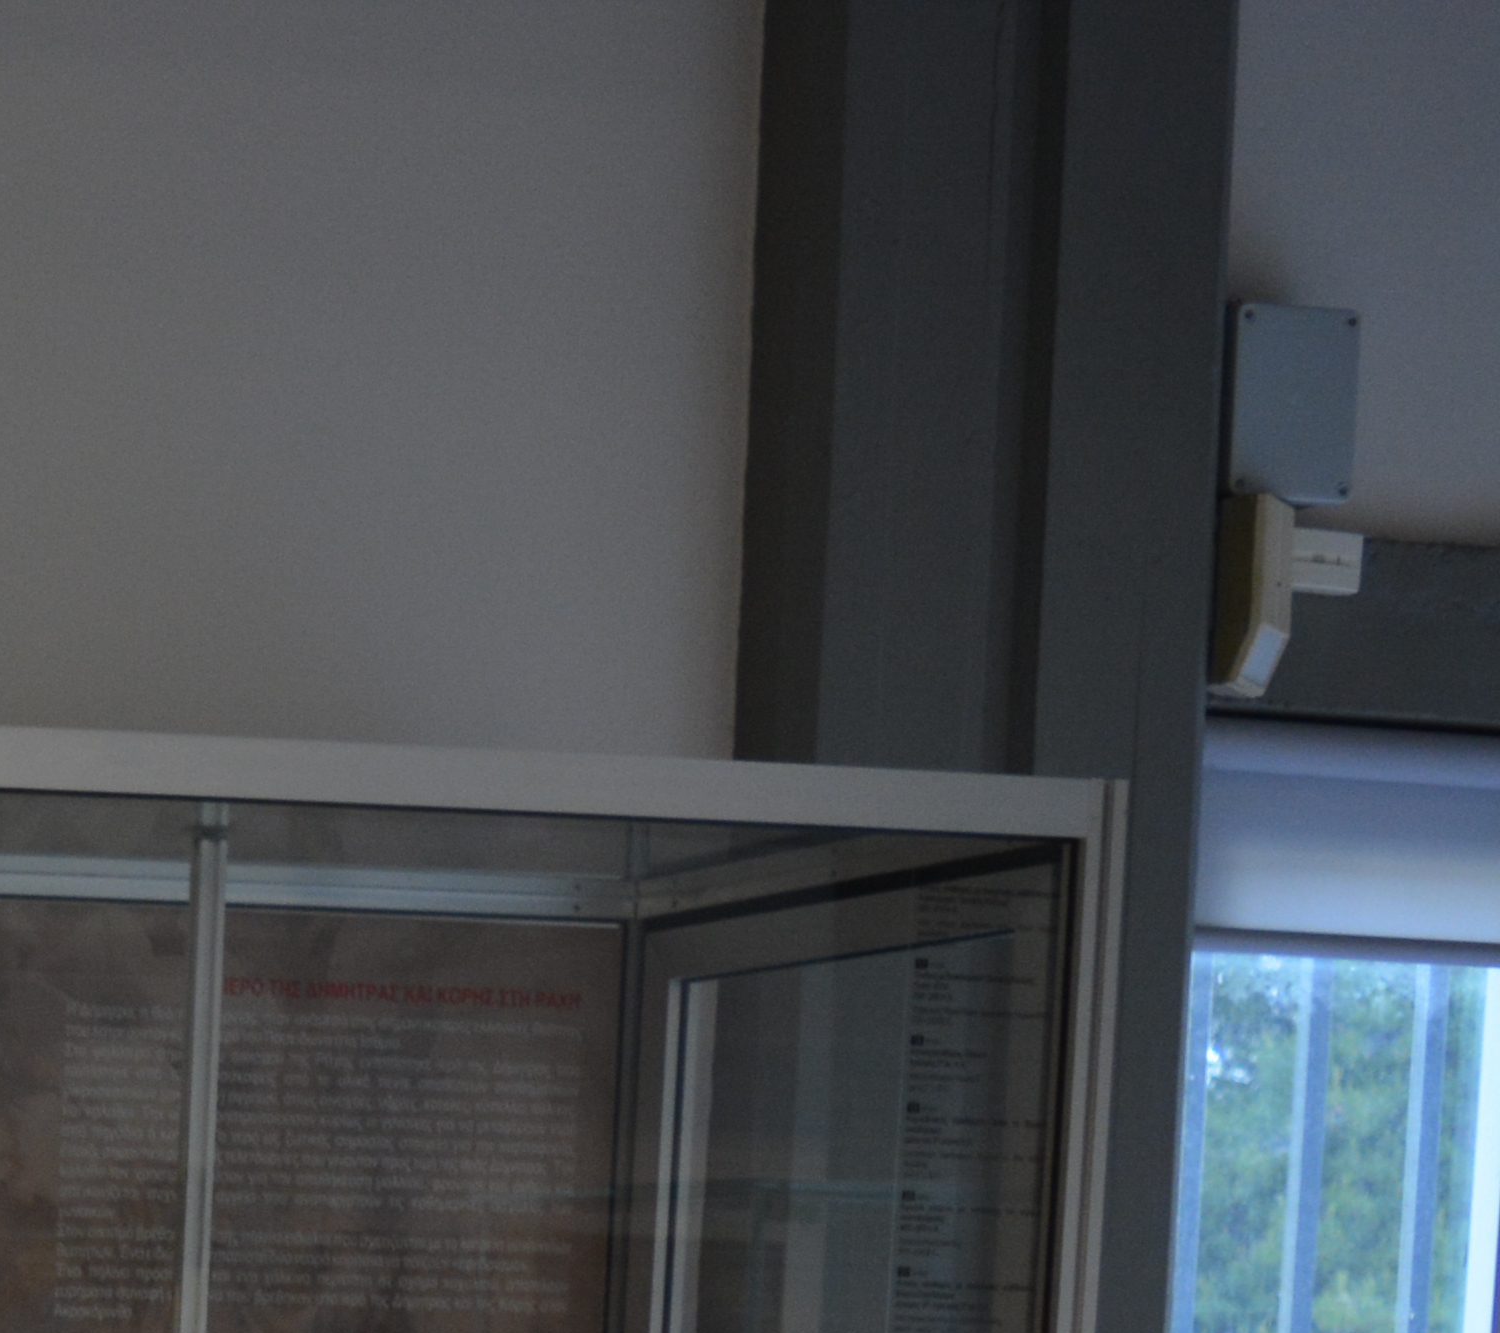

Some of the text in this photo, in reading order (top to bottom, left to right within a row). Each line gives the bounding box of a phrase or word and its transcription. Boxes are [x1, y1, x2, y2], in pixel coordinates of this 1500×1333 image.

[269, 979, 300, 998] ΤΗΣ
[306, 980, 399, 1003] ΔΗΜΗΤΡΑΣ
[404, 983, 434, 1004] ΚΑΙ
[437, 985, 494, 1006] ΚΟΡΗΣ
[499, 988, 530, 1008] ΣΤΗ
[534, 989, 581, 1010] ΡΑΧΗ
